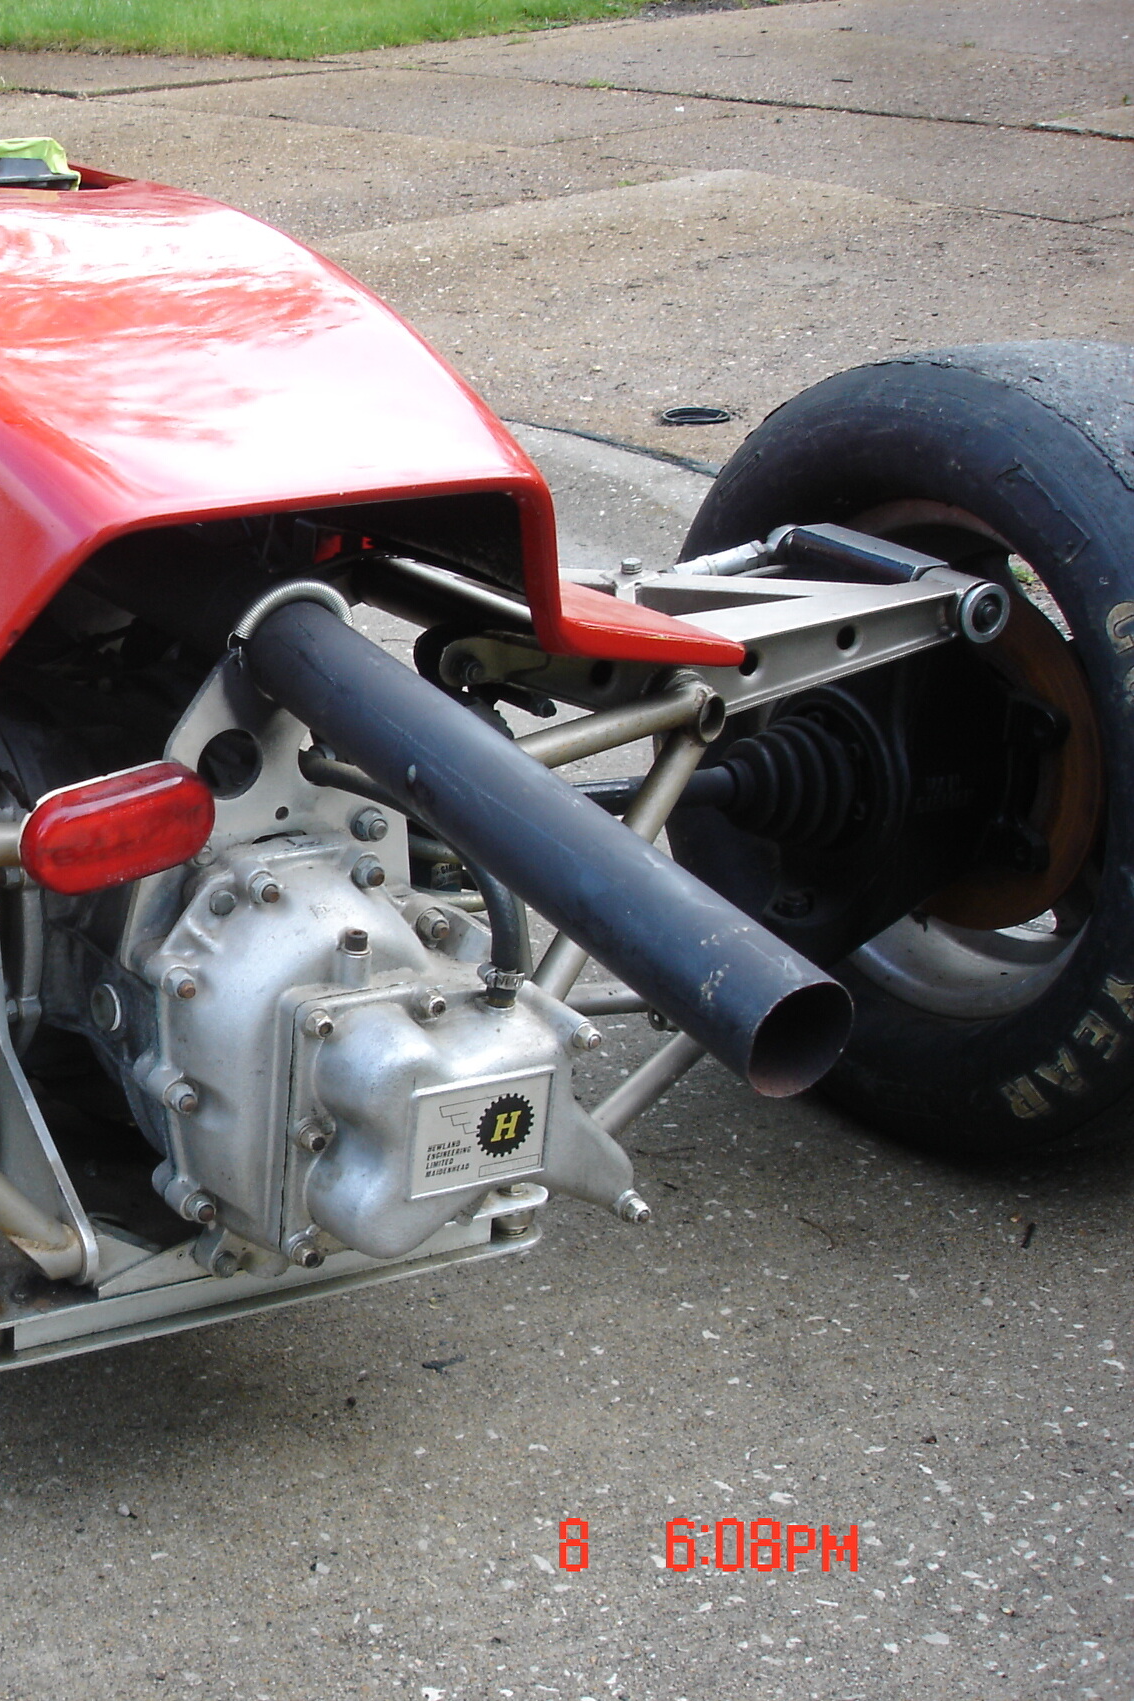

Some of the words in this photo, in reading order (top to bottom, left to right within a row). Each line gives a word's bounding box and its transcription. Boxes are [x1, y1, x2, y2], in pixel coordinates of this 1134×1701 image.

[490, 1110, 522, 1142] H
[427, 1140, 461, 1152] HEWLAND
[427, 1146, 472, 1161] ENGINEERING
[425, 1163, 470, 1177] MAIDENHEAD
[426, 1158, 454, 1170] LIMITED
